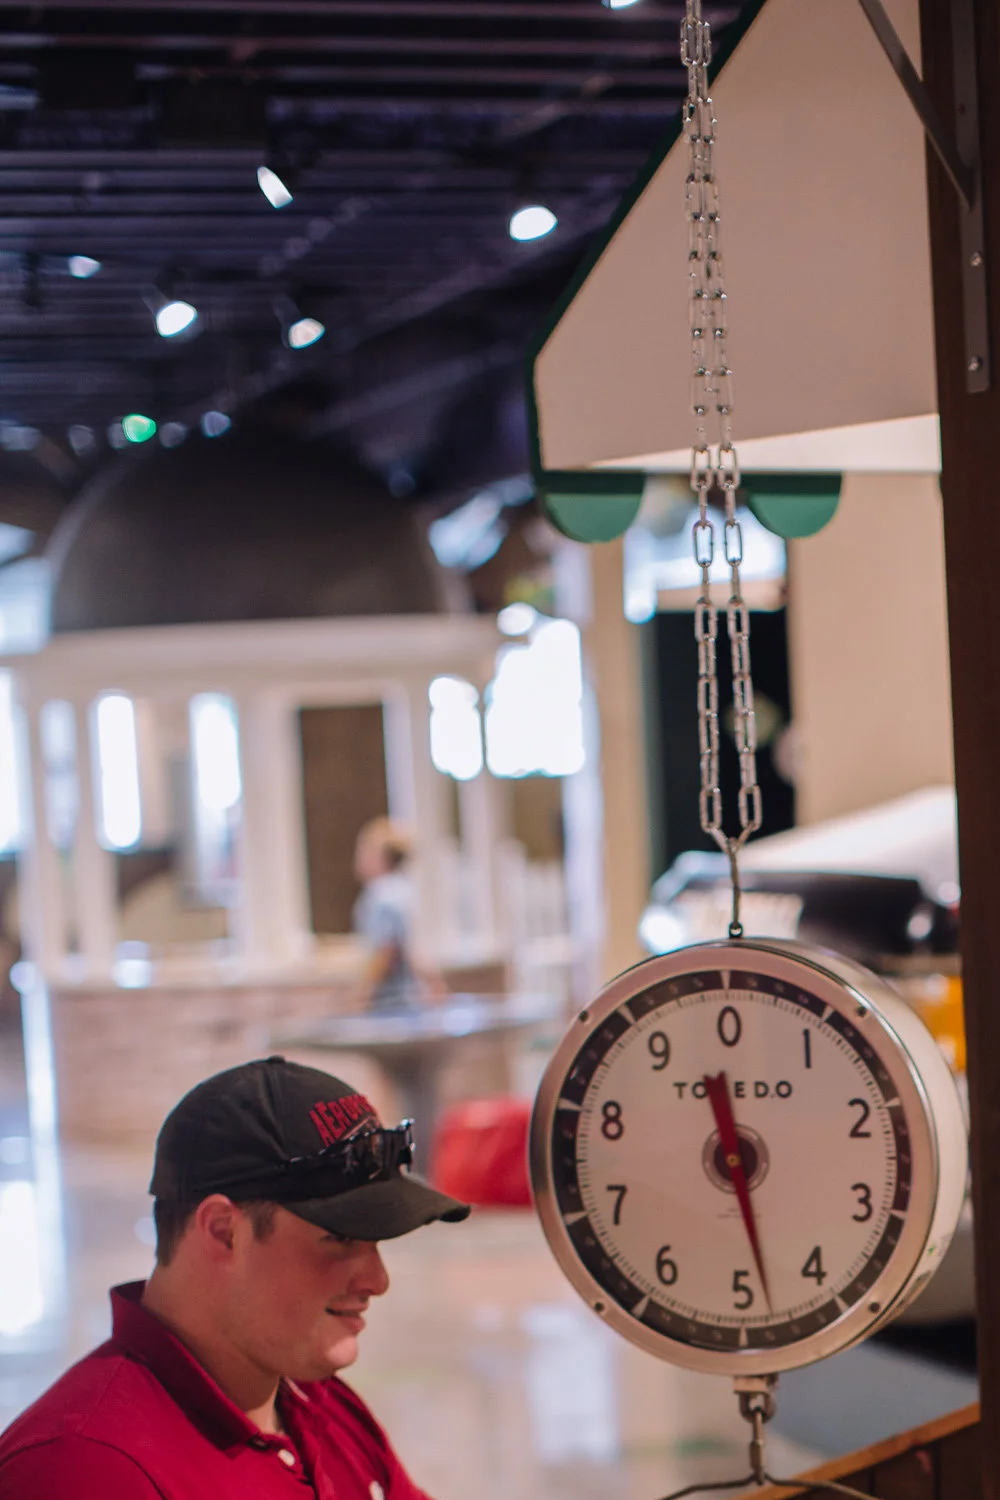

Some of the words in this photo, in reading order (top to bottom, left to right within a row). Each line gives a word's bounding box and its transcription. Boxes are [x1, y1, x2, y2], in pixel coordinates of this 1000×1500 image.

[717, 1006, 742, 1047] 0
[648, 1031, 671, 1071] 9
[802, 1029, 813, 1069] 1
[672, 1080, 793, 1099] TOEDO
[601, 1101, 624, 1140] 8
[847, 1098, 871, 1138] 2
[606, 1185, 628, 1225] 7
[851, 1183, 873, 1222] 3
[655, 1245, 678, 1286] 6
[801, 1246, 826, 1286] 4
[731, 1270, 754, 1310] 5
